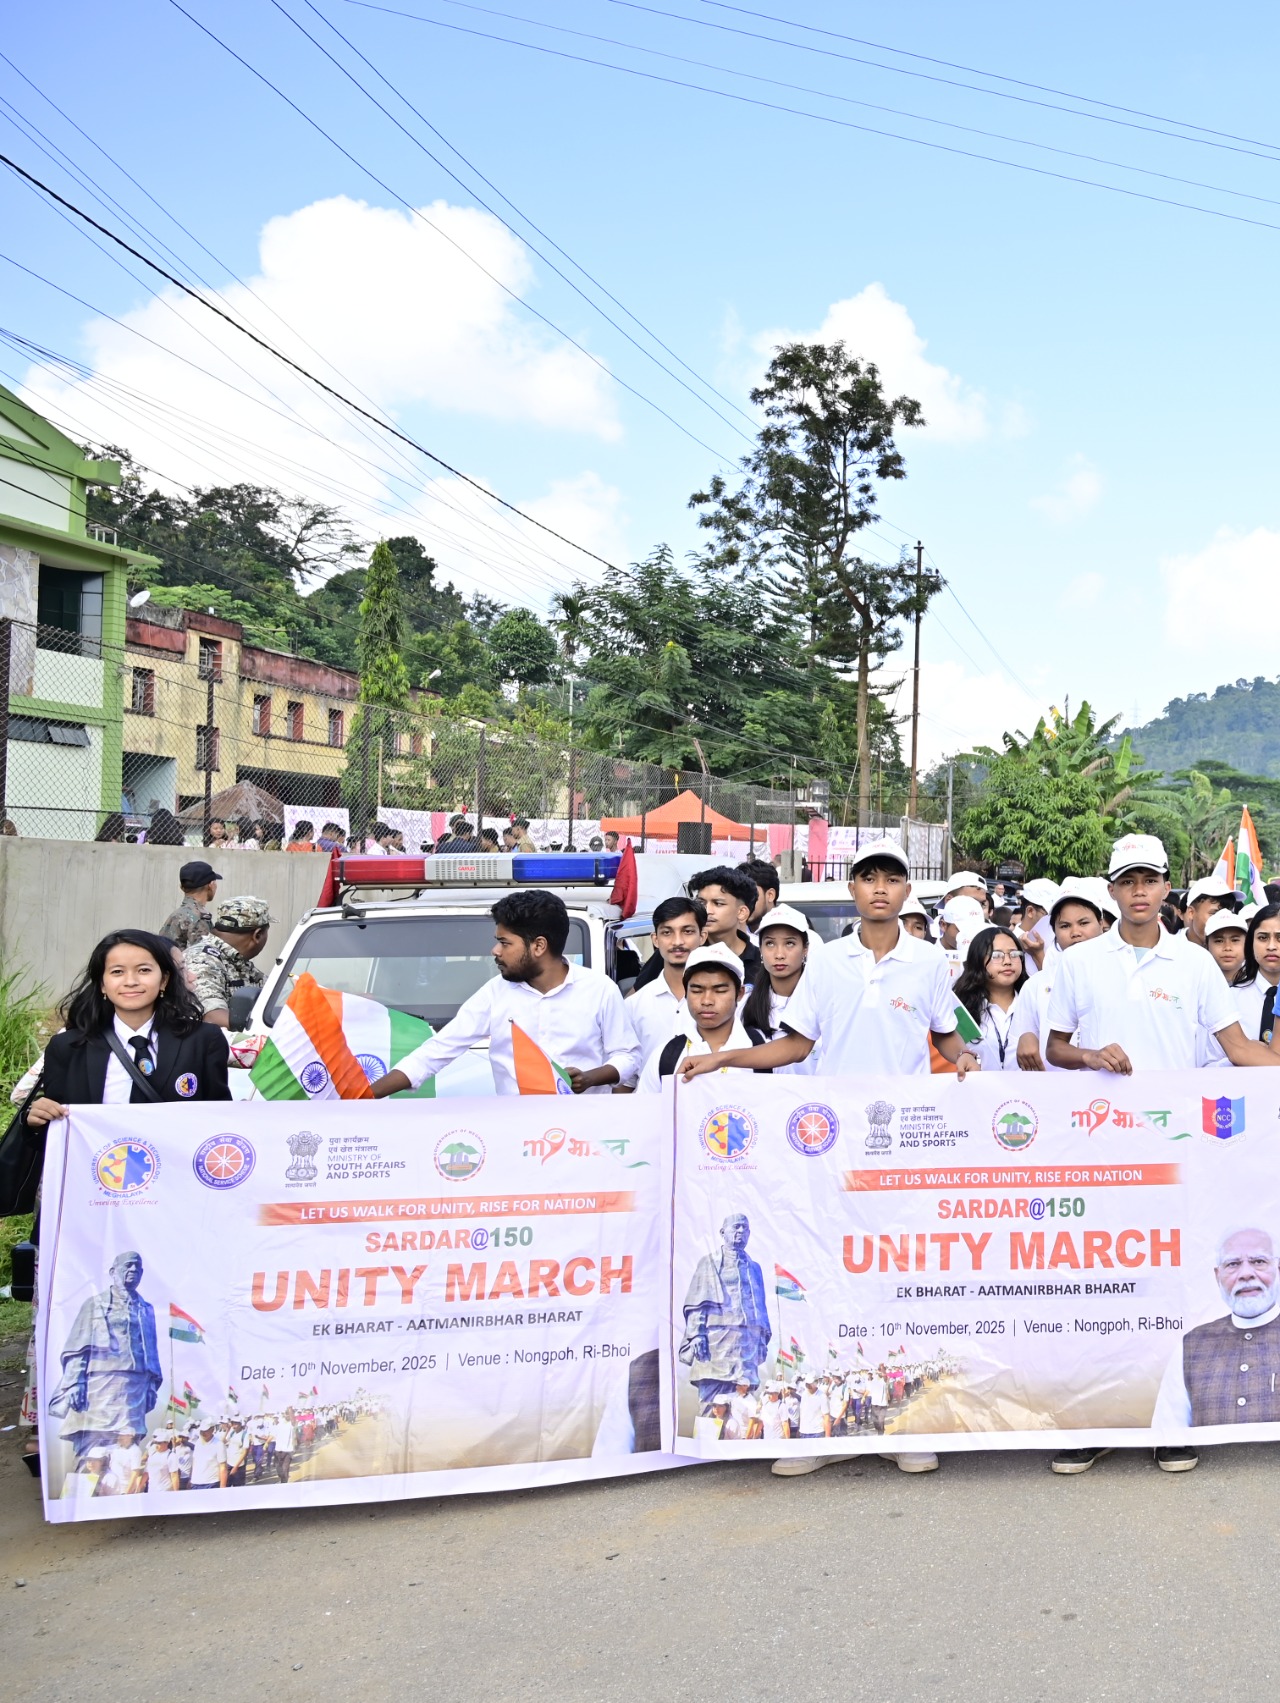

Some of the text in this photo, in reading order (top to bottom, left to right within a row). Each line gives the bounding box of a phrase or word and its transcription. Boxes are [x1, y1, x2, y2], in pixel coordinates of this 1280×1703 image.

[716, 1104, 741, 1112] SCIENCE
[1216, 1114, 1232, 1123] NCC
[900, 1122, 947, 1131] MINISTRY OF
[900, 1130, 969, 1140] YOUTH AFFAIRS
[113, 1136, 142, 1145] SCIENCE
[329, 1135, 370, 1146] युवा कार्यक्रम
[899, 1139, 956, 1148] AND SPORTS
[340, 1145, 353, 1153] खेल
[354, 1144, 378, 1153] मंत्रालय
[327, 1153, 382, 1162] MINISTRY OF
[327, 1161, 406, 1171] YOUTH AFFAIRS
[326, 1170, 391, 1180] AND SPORTS
[879, 1169, 1143, 1186] LET US WALK FOR UNITY, RISE FOR NATION
[103, 1190, 144, 1199] MEGHALAYA
[122, 1198, 159, 1206] Excellence
[301, 1198, 597, 1220] LET US WALK FOR UNITY, RISE FOR NATION
[937, 1197, 1086, 1221] SARDAR@150
[365, 1226, 533, 1253] SARDAR@150
[842, 1228, 1181, 1274] UNITY MARCH
[251, 1255, 634, 1311] UNITY MARCH
[896, 1282, 1136, 1298] EK BHARAT AATMANIRBHAR BHARAT
[312, 1310, 583, 1337] EK BHARAT AATMANIRBHAR BHARAT
[838, 1315, 1184, 1338] Date 10th November, 2025 Venue Nongpoh, Ri-Bhoi
[241, 1344, 632, 1381] Date 10th November, 2025 Venue Nongpoh, Ri-Bhoi
